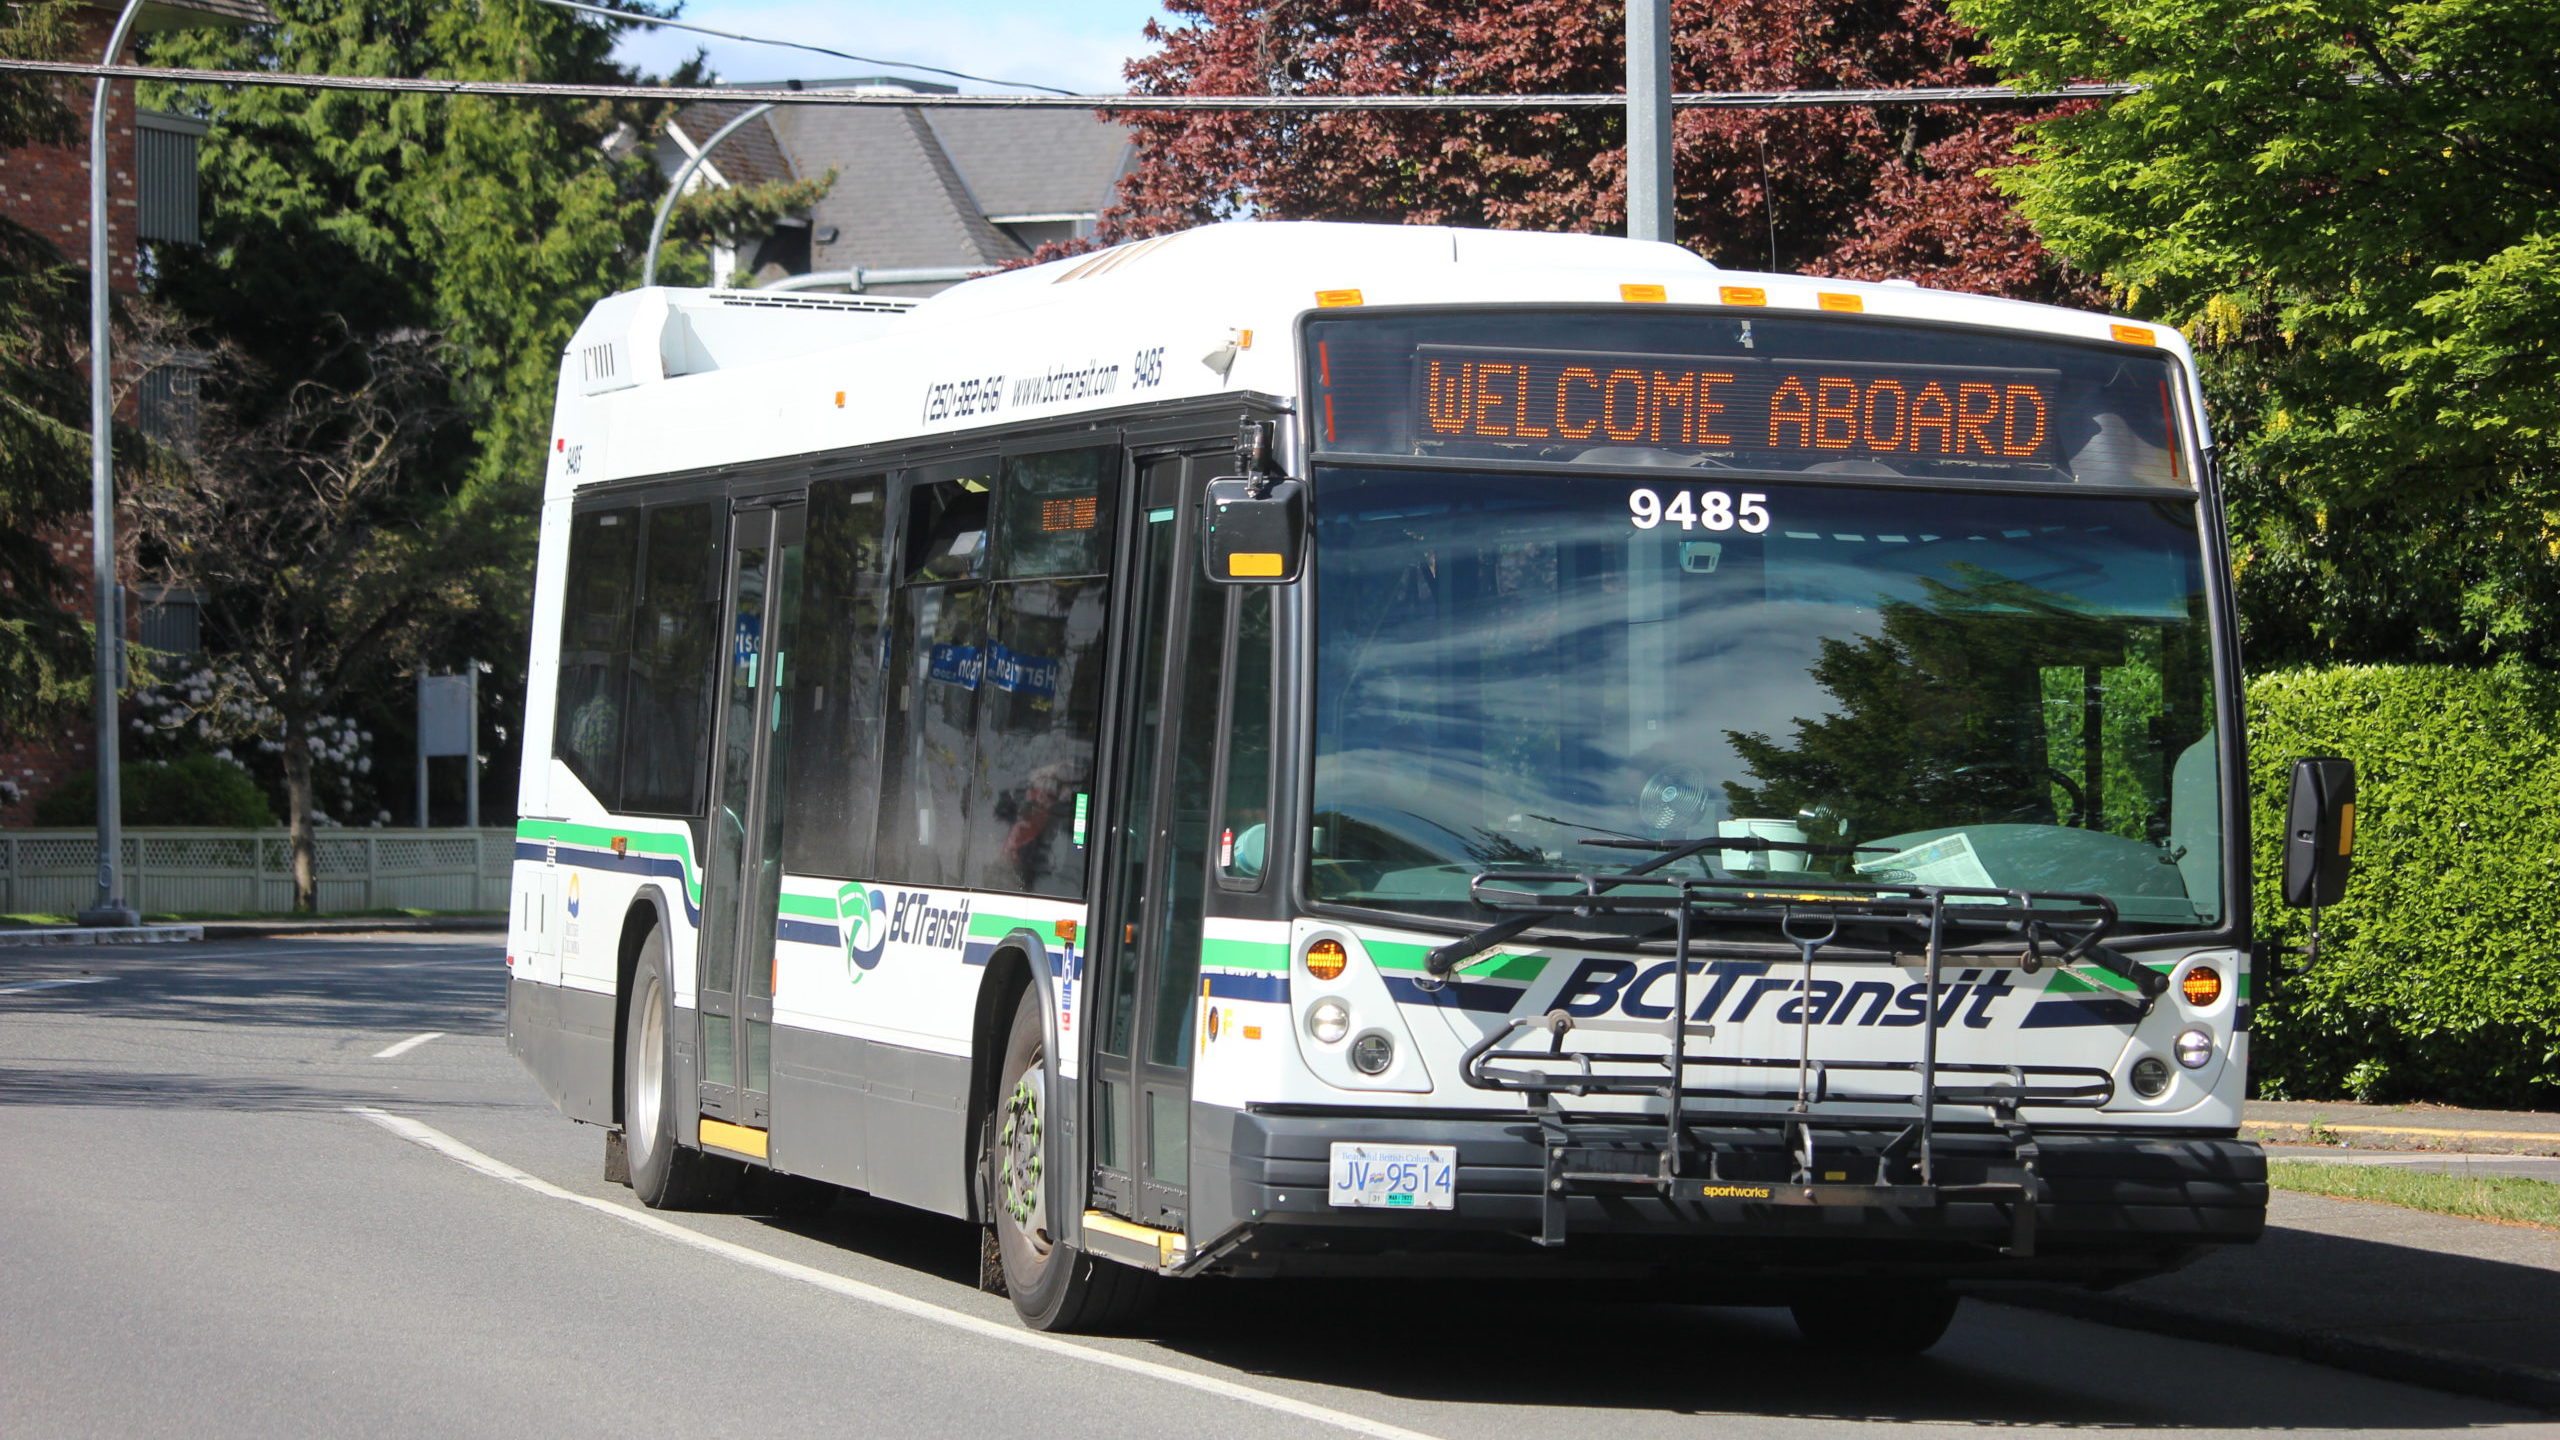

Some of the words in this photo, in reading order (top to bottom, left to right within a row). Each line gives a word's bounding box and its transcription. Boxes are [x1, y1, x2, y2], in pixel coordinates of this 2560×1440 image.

[1012, 359, 1119, 408] www.bctransit.com
[1132, 347, 1165, 390] 9485
[1428, 361, 1734, 445] WELCOME
[1768, 376, 2046, 456] ABOARD
[1629, 488, 1770, 534] 9485
[888, 891, 970, 951] BCTransit
[1542, 957, 2016, 1029] BCTransit
[1337, 1161, 1370, 1191] JV
[1386, 1163, 1451, 1193] 9514
[1703, 1186, 1769, 1199] sportworks
